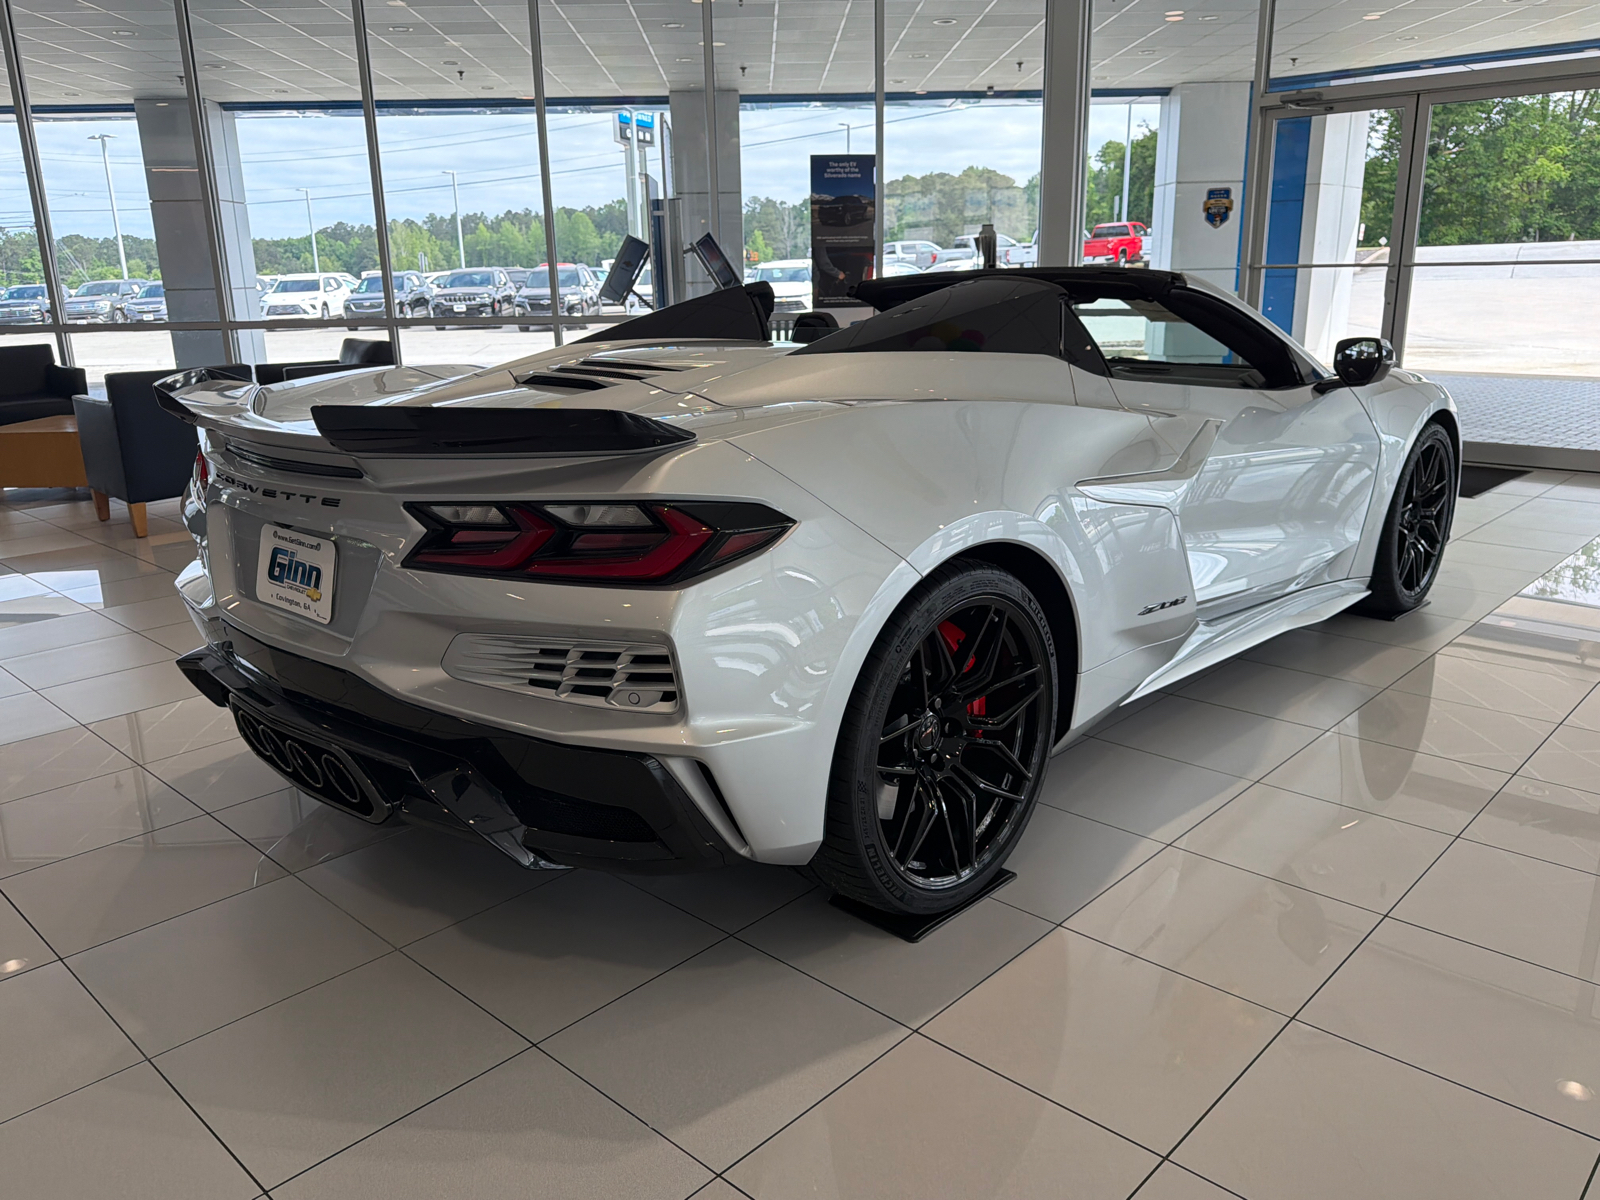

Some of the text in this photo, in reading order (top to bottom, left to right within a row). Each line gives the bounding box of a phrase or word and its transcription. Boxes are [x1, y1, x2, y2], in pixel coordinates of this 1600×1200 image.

[216, 472, 341, 508] CORVETTE
[268, 546, 322, 591] Ginn
[275, 593, 311, 612] Covington, GA
[286, 584, 307, 595] CHEVROLET
[1137, 595, 1188, 616] Z06
[1029, 600, 1055, 656] MICHELIN
[866, 847, 905, 899] MICHELIN
